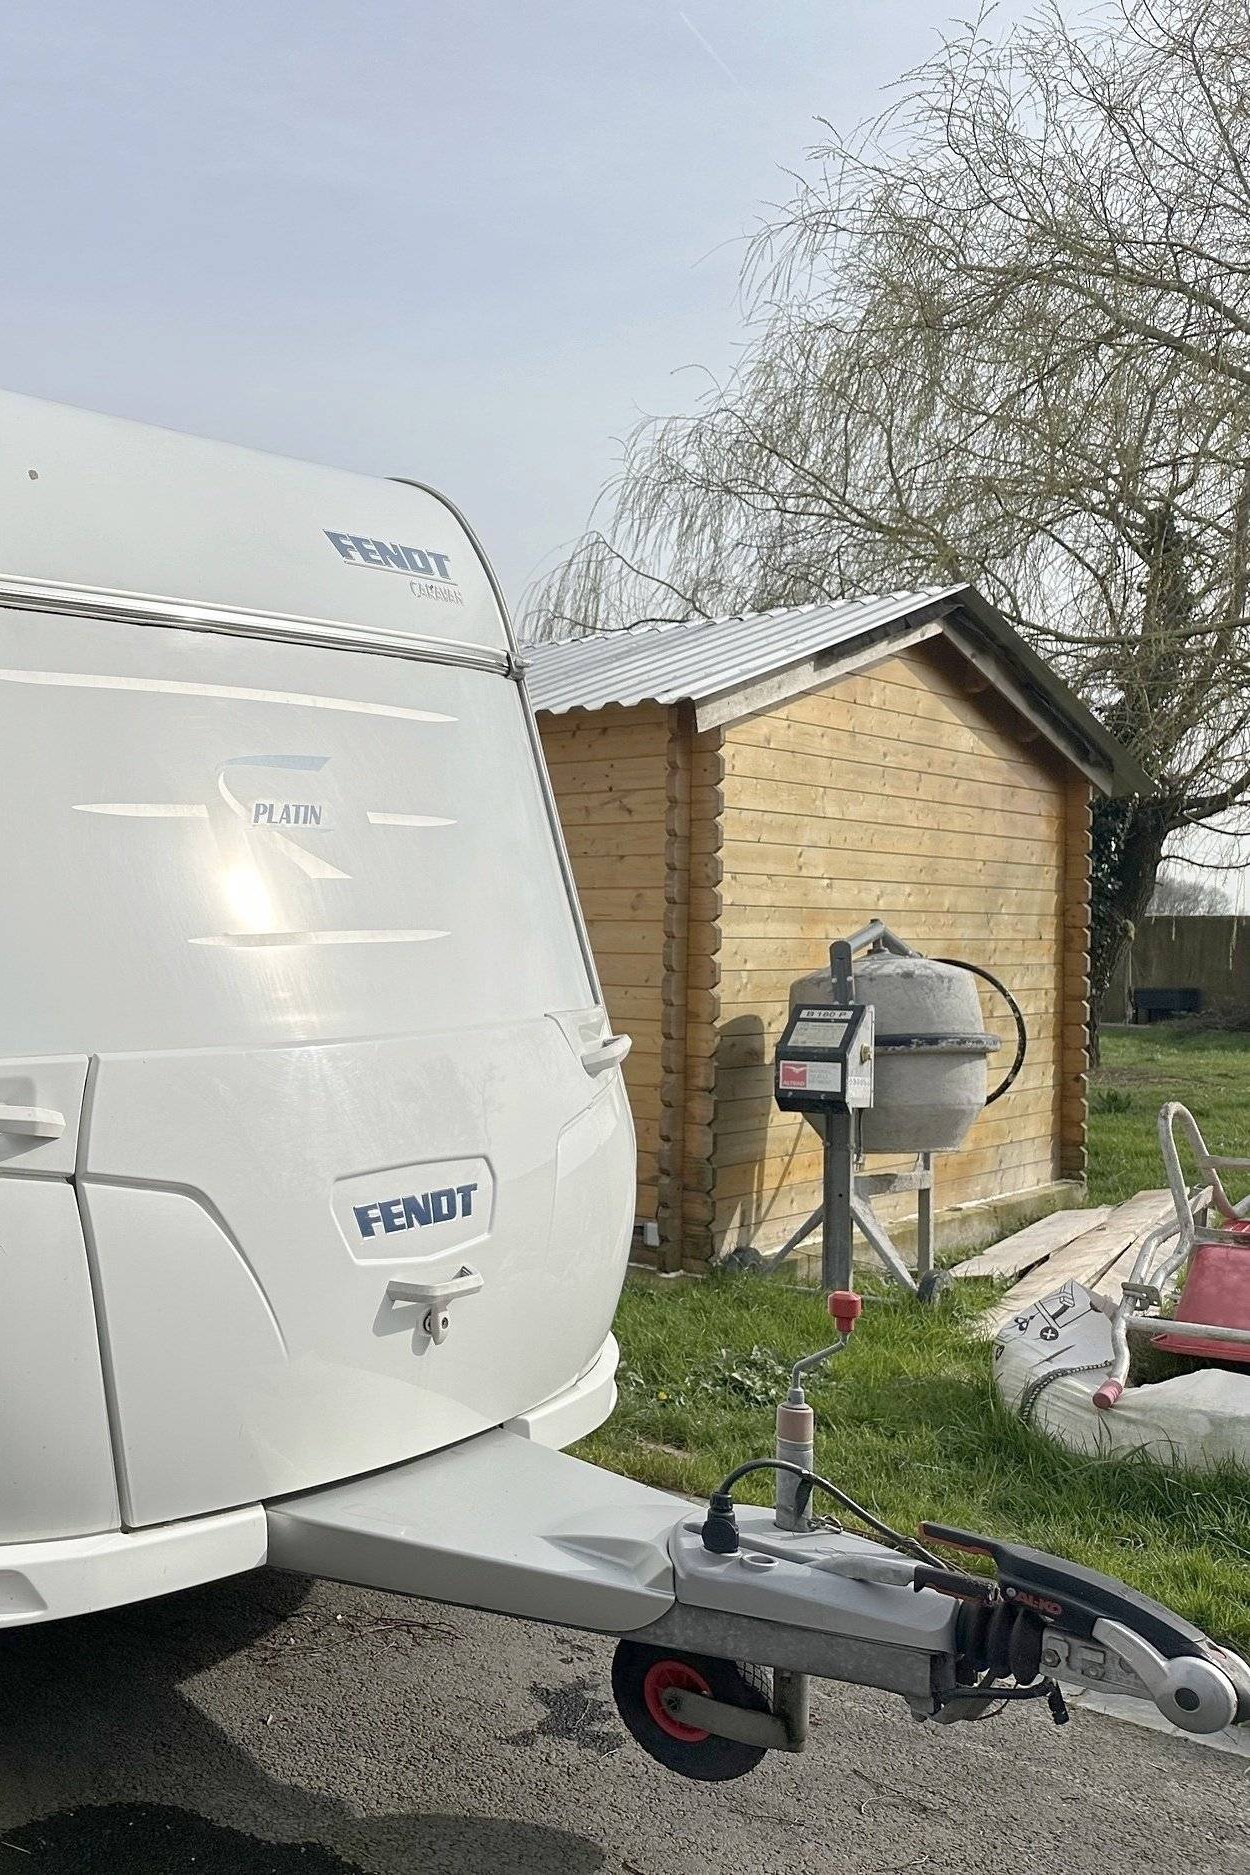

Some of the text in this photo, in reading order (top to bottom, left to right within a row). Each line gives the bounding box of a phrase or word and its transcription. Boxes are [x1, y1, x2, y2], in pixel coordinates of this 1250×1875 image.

[322, 529, 451, 580] FENDT
[253, 803, 322, 825] PLATIN
[353, 1183, 478, 1238] FENDT
